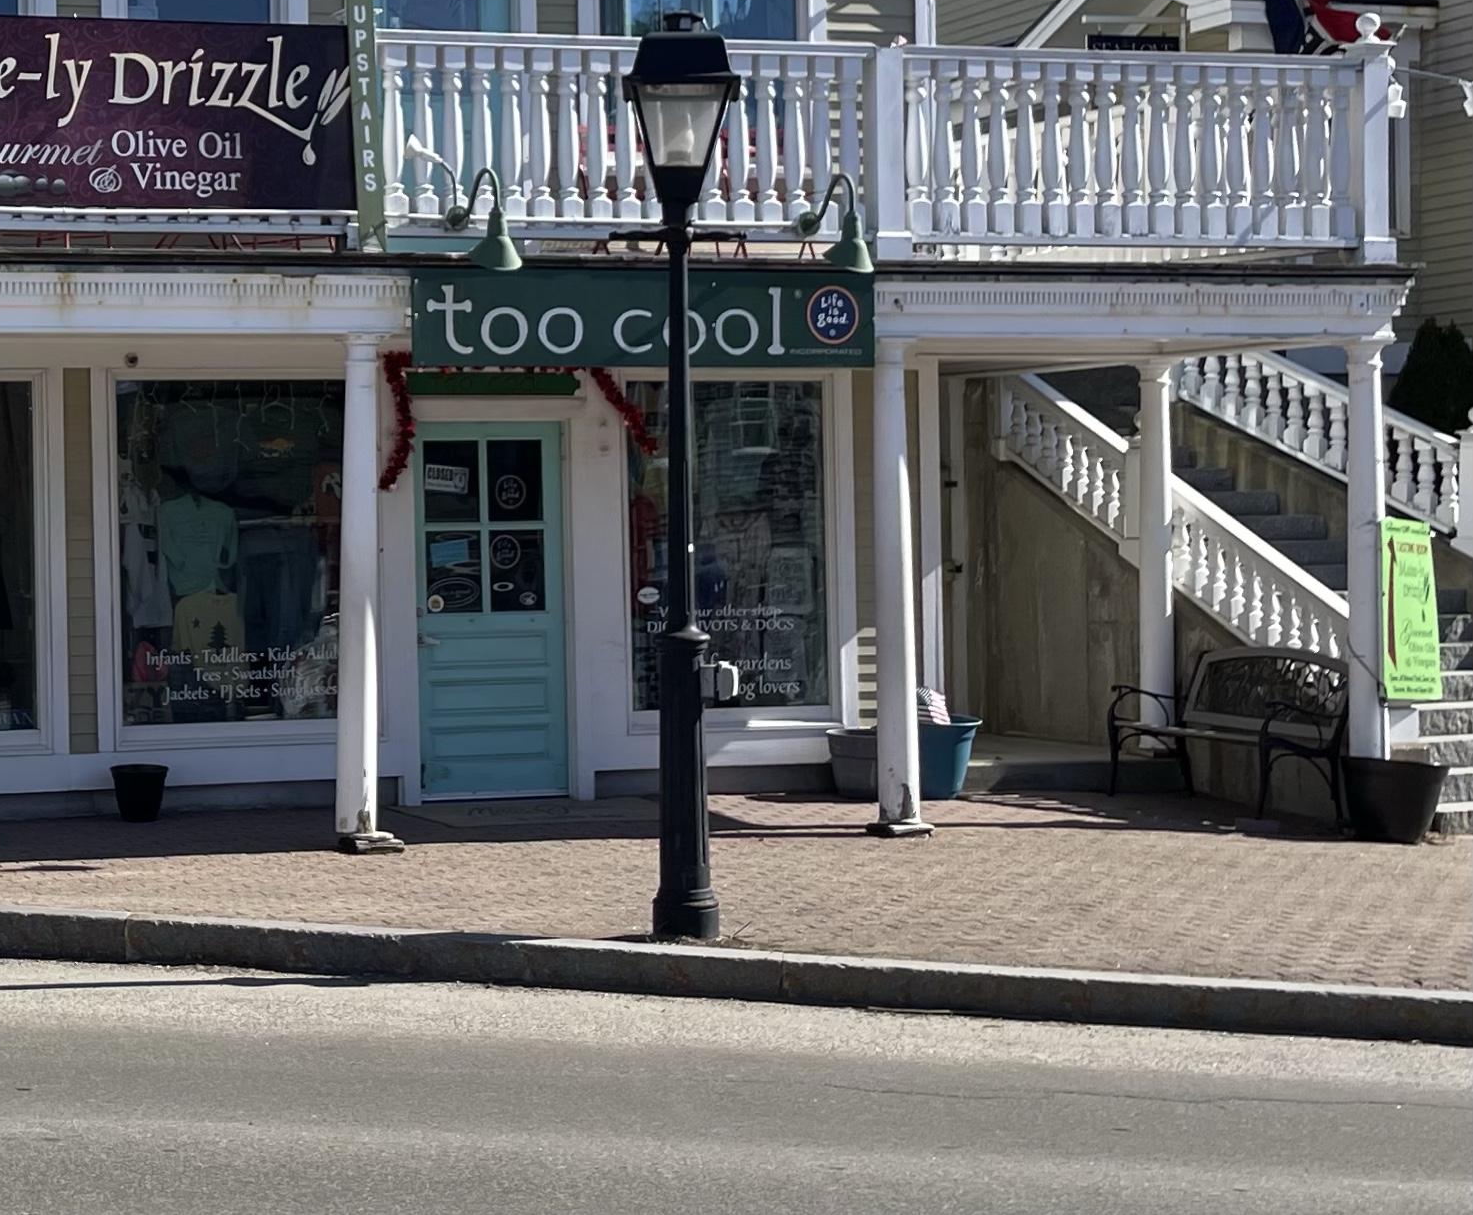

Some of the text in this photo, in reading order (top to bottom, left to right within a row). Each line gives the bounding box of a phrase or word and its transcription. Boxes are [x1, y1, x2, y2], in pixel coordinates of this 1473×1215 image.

[108, 35, 316, 135] Drizzle
[353, 5, 377, 192] UPSTAIRS
[111, 130, 188, 158] Olive
[198, 131, 243, 159] Oil
[89, 162, 241, 198] & Vinegar
[820, 293, 844, 309] Life
[828, 307, 840, 316] is
[426, 284, 785, 355] too cool
[715, 603, 747, 617] other
[751, 603, 783, 619] shop
[697, 618, 796, 632] IVOTS & DOGS
[145, 645, 338, 671] Infants Toddlers Kids Adul
[193, 667, 222, 682] Tees
[162, 685, 210, 706] Jackets
[220, 684, 233, 704] PJ
[236, 684, 262, 699] Sets
[272, 682, 338, 701] Sunglasses
[738, 675, 801, 701] og lovers
